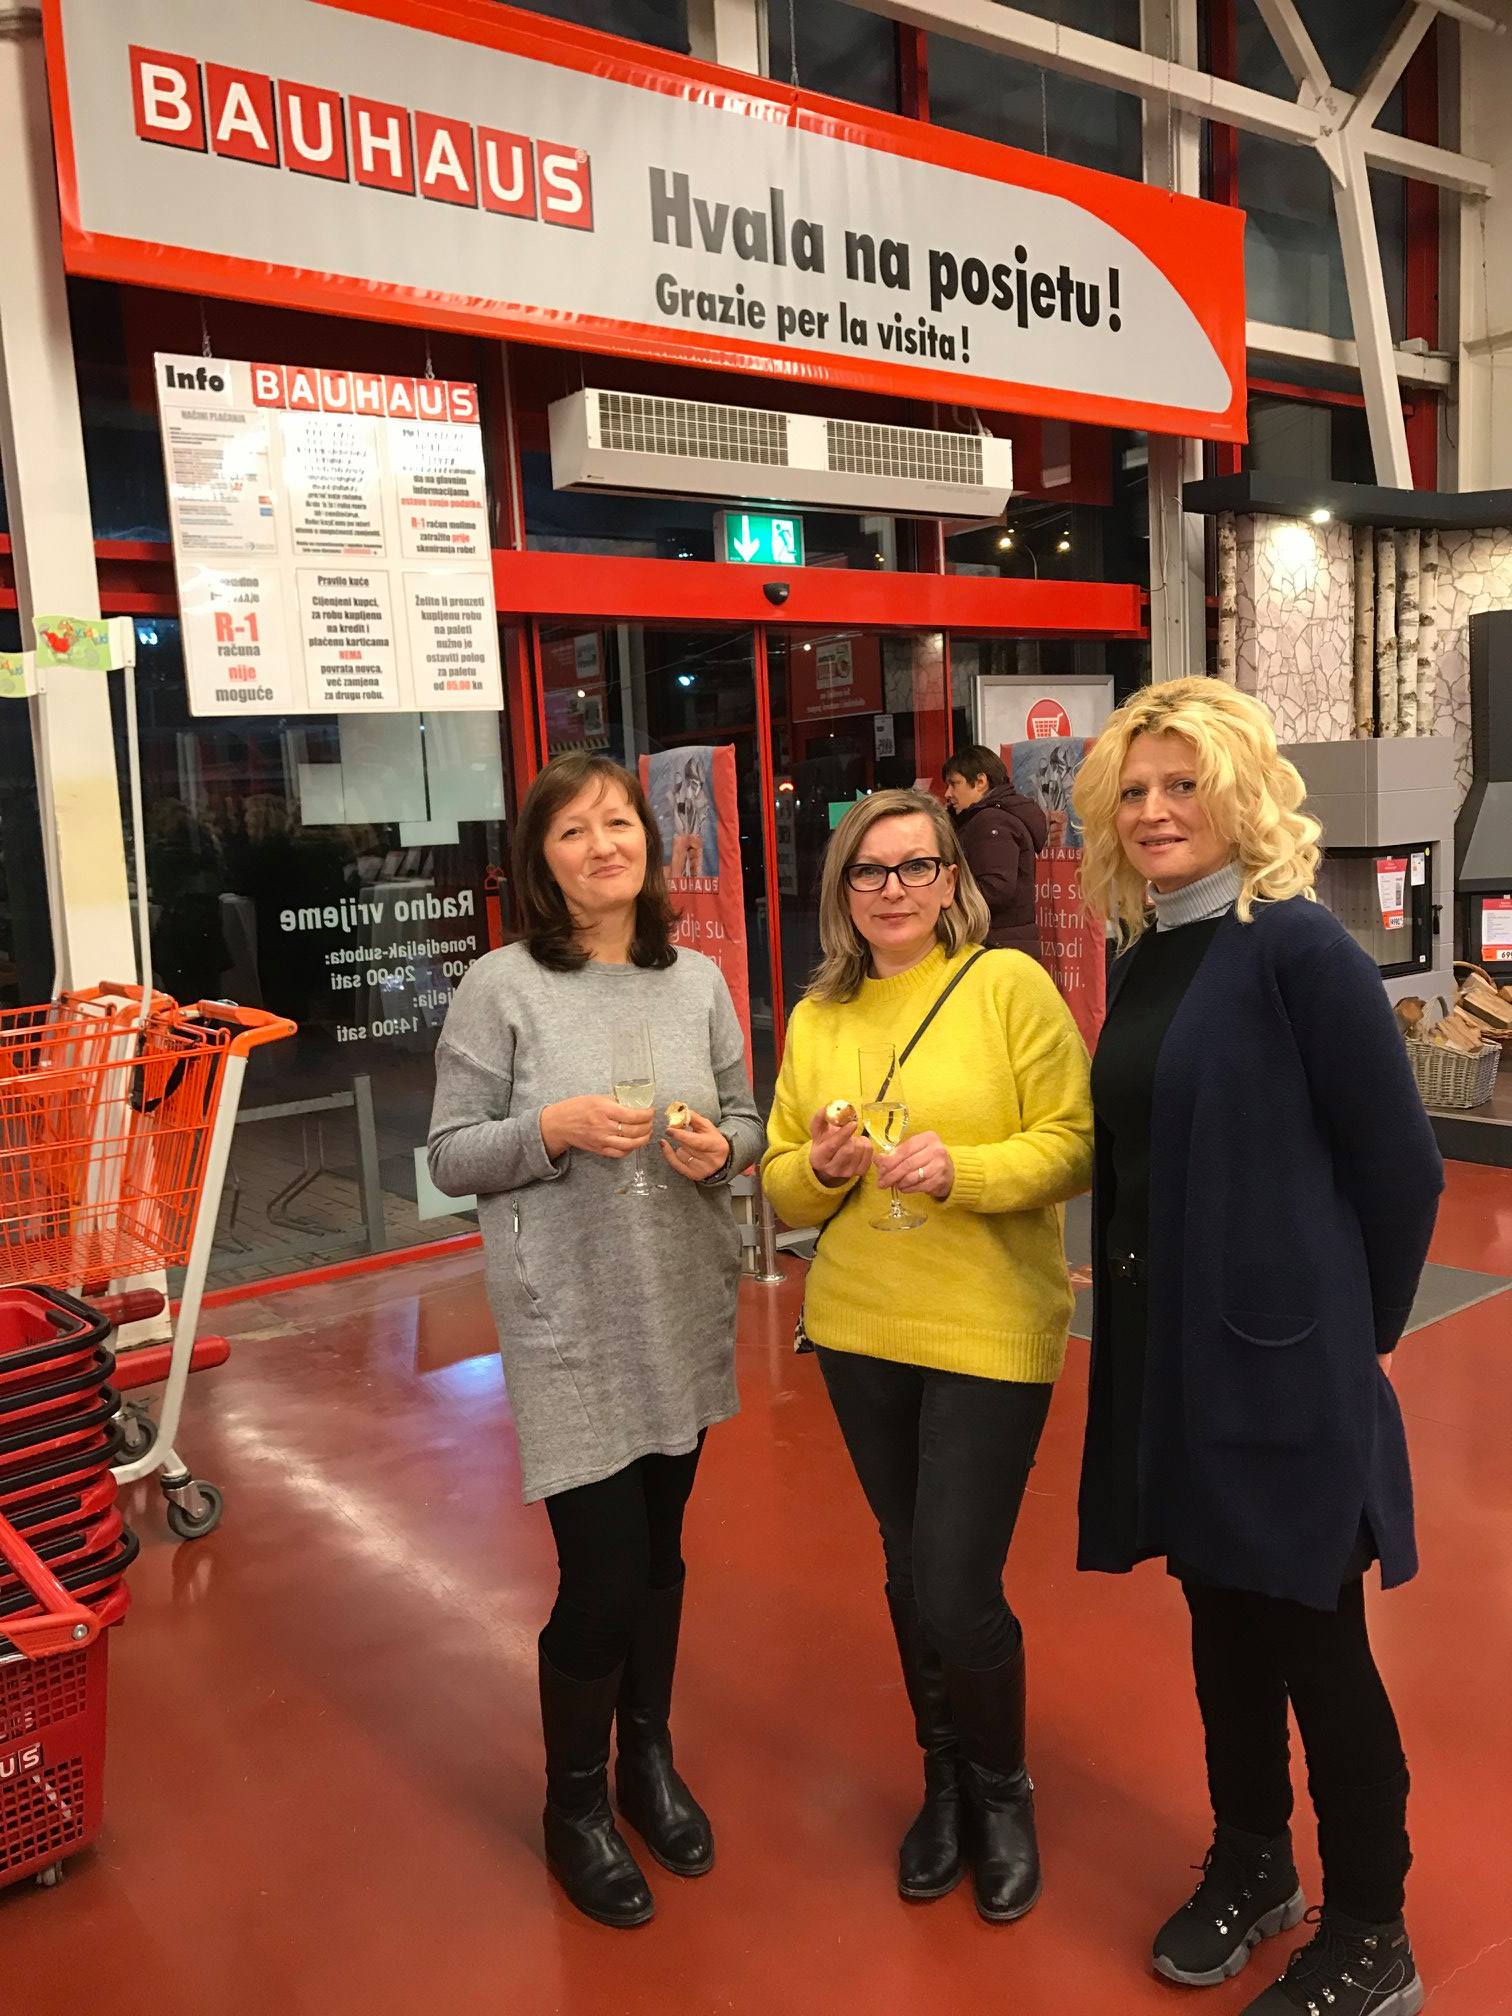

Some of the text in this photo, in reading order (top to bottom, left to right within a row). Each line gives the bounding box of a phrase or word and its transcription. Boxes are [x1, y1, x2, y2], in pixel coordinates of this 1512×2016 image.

[138, 60, 584, 215] BAUHAUS
[648, 165, 1122, 333] Hvala na posjetu!
[655, 272, 971, 364] Grazie per la visita!
[165, 365, 225, 392] Info
[255, 368, 474, 417] BAUHAUS
[412, 485, 469, 497] informacijama
[317, 575, 370, 587] Pravilo kuće
[312, 596, 351, 607] Cijenjeni
[415, 593, 441, 607] Želite
[311, 610, 382, 621] za robu kupljenu
[421, 610, 482, 621] kupljenu robu
[214, 611, 259, 642] R-1
[326, 625, 338, 634] na
[339, 624, 365, 634] kredit
[434, 624, 473, 636] na paleti
[308, 637, 390, 648] plaćenu karticama
[436, 638, 463, 649] nužno
[217, 643, 261, 657] računa
[338, 650, 362, 660] NEMA
[426, 653, 486, 664] ostaviti polog
[228, 664, 257, 682] nije
[320, 665, 354, 675] povrata
[437, 667, 477, 678] za paletu
[326, 677, 379, 688] već zamjena
[433, 681, 445, 691] od
[472, 680, 483, 690] kn
[215, 685, 274, 704] moguće
[324, 691, 334, 701] za
[335, 690, 361, 702] drugu
[705, 919, 725, 939] su
